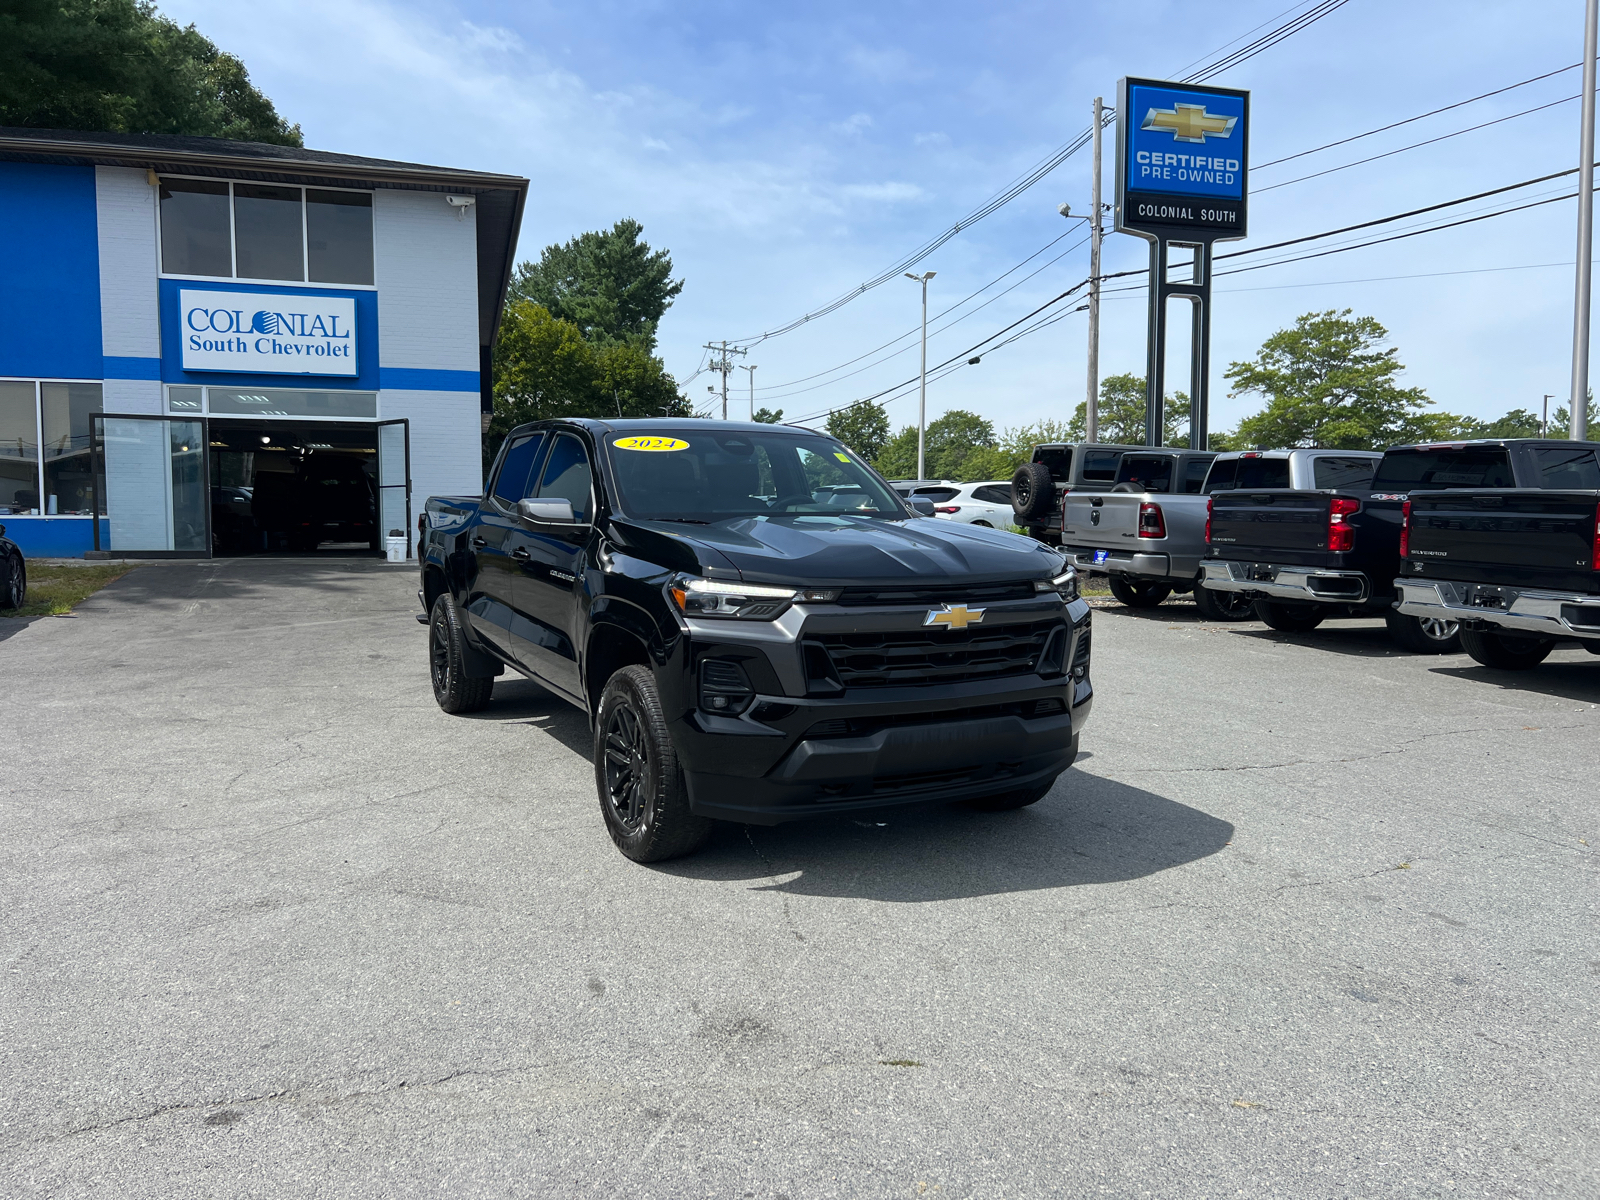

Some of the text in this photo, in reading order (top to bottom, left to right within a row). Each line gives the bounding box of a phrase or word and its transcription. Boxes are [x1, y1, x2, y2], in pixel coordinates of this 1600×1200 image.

[1136, 150, 1240, 172] CERTIFIED
[1141, 165, 1235, 185] PRE-OWNED
[1138, 203, 1236, 223] COLONIAL SOUTH
[187, 307, 350, 339] COLONIAL
[189, 334, 350, 358] South Chevrolet
[626, 439, 677, 449] 2024
[1411, 549, 1447, 557] SILVERADO
